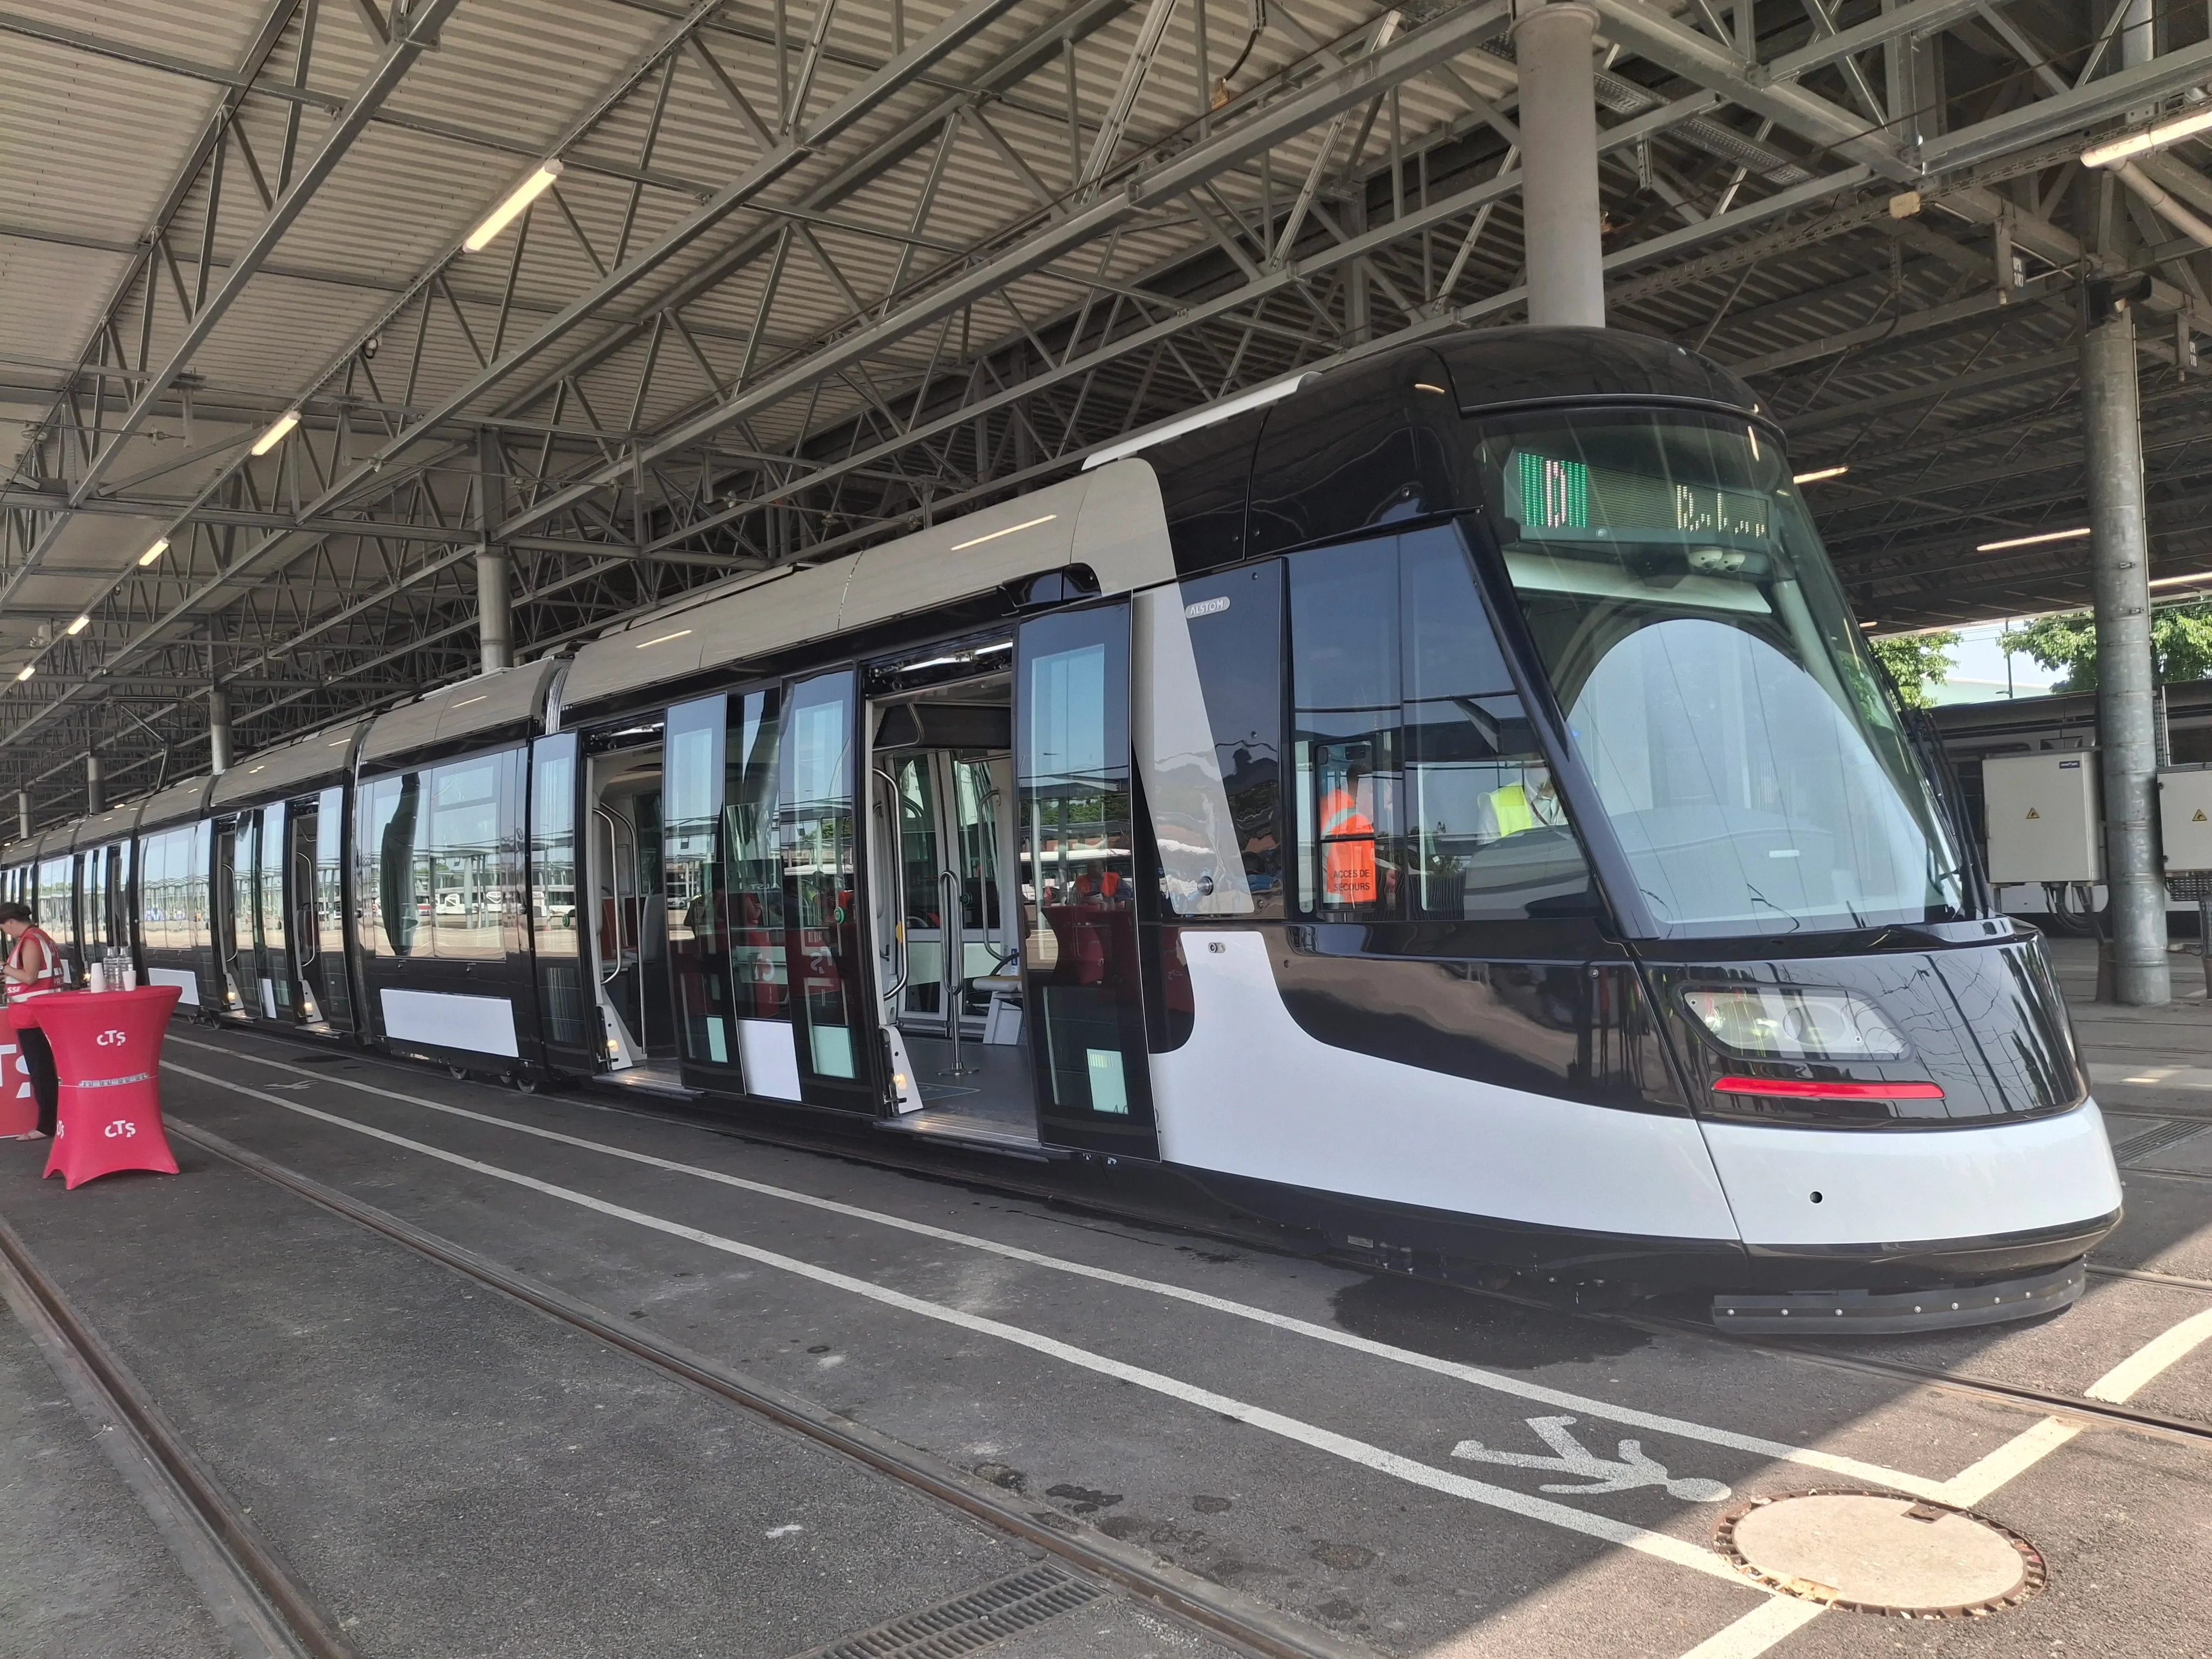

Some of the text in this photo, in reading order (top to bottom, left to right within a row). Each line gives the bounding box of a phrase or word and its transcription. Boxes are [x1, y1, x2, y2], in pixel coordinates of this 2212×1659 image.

[1190, 600, 1224, 615] ALSTOM
[1333, 869, 1369, 878] ACCES DE
[1333, 882, 1370, 891] SECOURS
[97, 1030, 126, 1046] CTS
[105, 1120, 136, 1137] CTS
